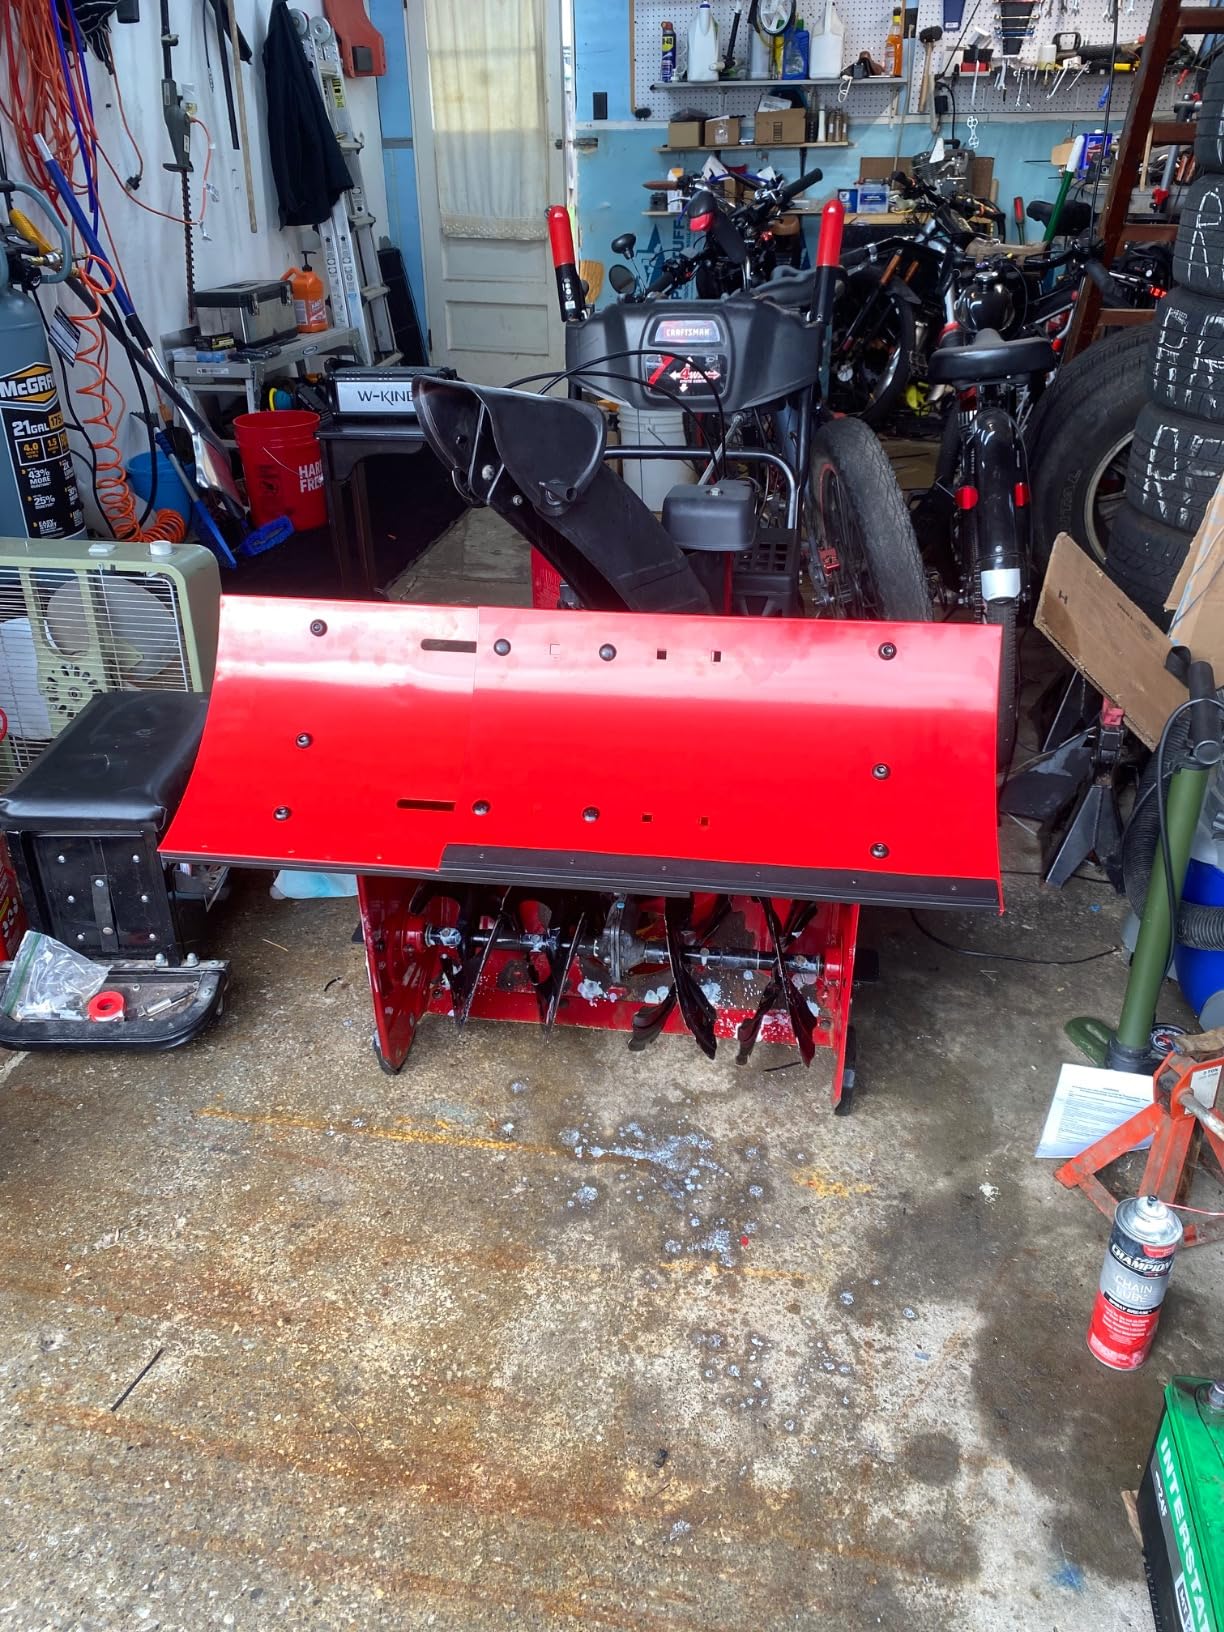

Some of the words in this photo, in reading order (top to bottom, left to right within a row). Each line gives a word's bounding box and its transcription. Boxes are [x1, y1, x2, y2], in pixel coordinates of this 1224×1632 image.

[666, 327, 710, 337] CRAFTSMAN
[0, 374, 55, 397] McGRA
[28, 468, 50, 479] 43%
[30, 476, 51, 485] MORE
[34, 495, 55, 506] 25%
[1112, 1244, 1171, 1272] CHAMPION
[1115, 1275, 1153, 1293] CHAIN
